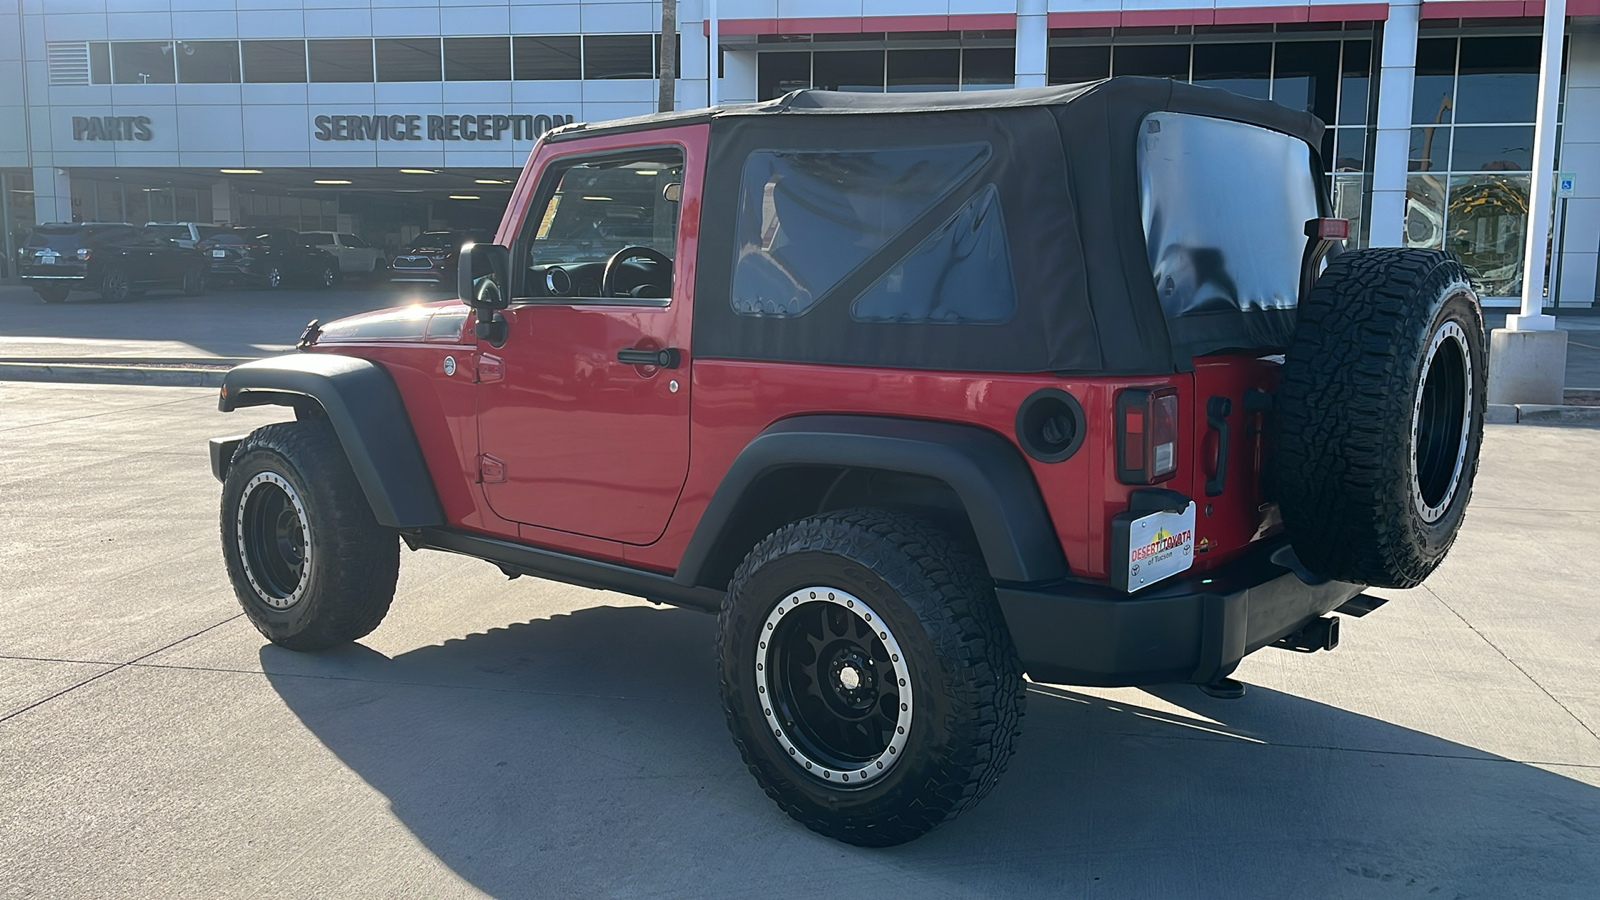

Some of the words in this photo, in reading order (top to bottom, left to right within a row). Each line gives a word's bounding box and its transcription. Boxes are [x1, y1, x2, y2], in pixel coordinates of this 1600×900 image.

[72, 116, 153, 141] PARTS
[314, 114, 422, 141] SERVICE
[1131, 541, 1161, 563] DESERT
[1162, 529, 1192, 550] TOYOTA
[1147, 558, 1154, 566] of
[1155, 551, 1173, 563] Tucson
